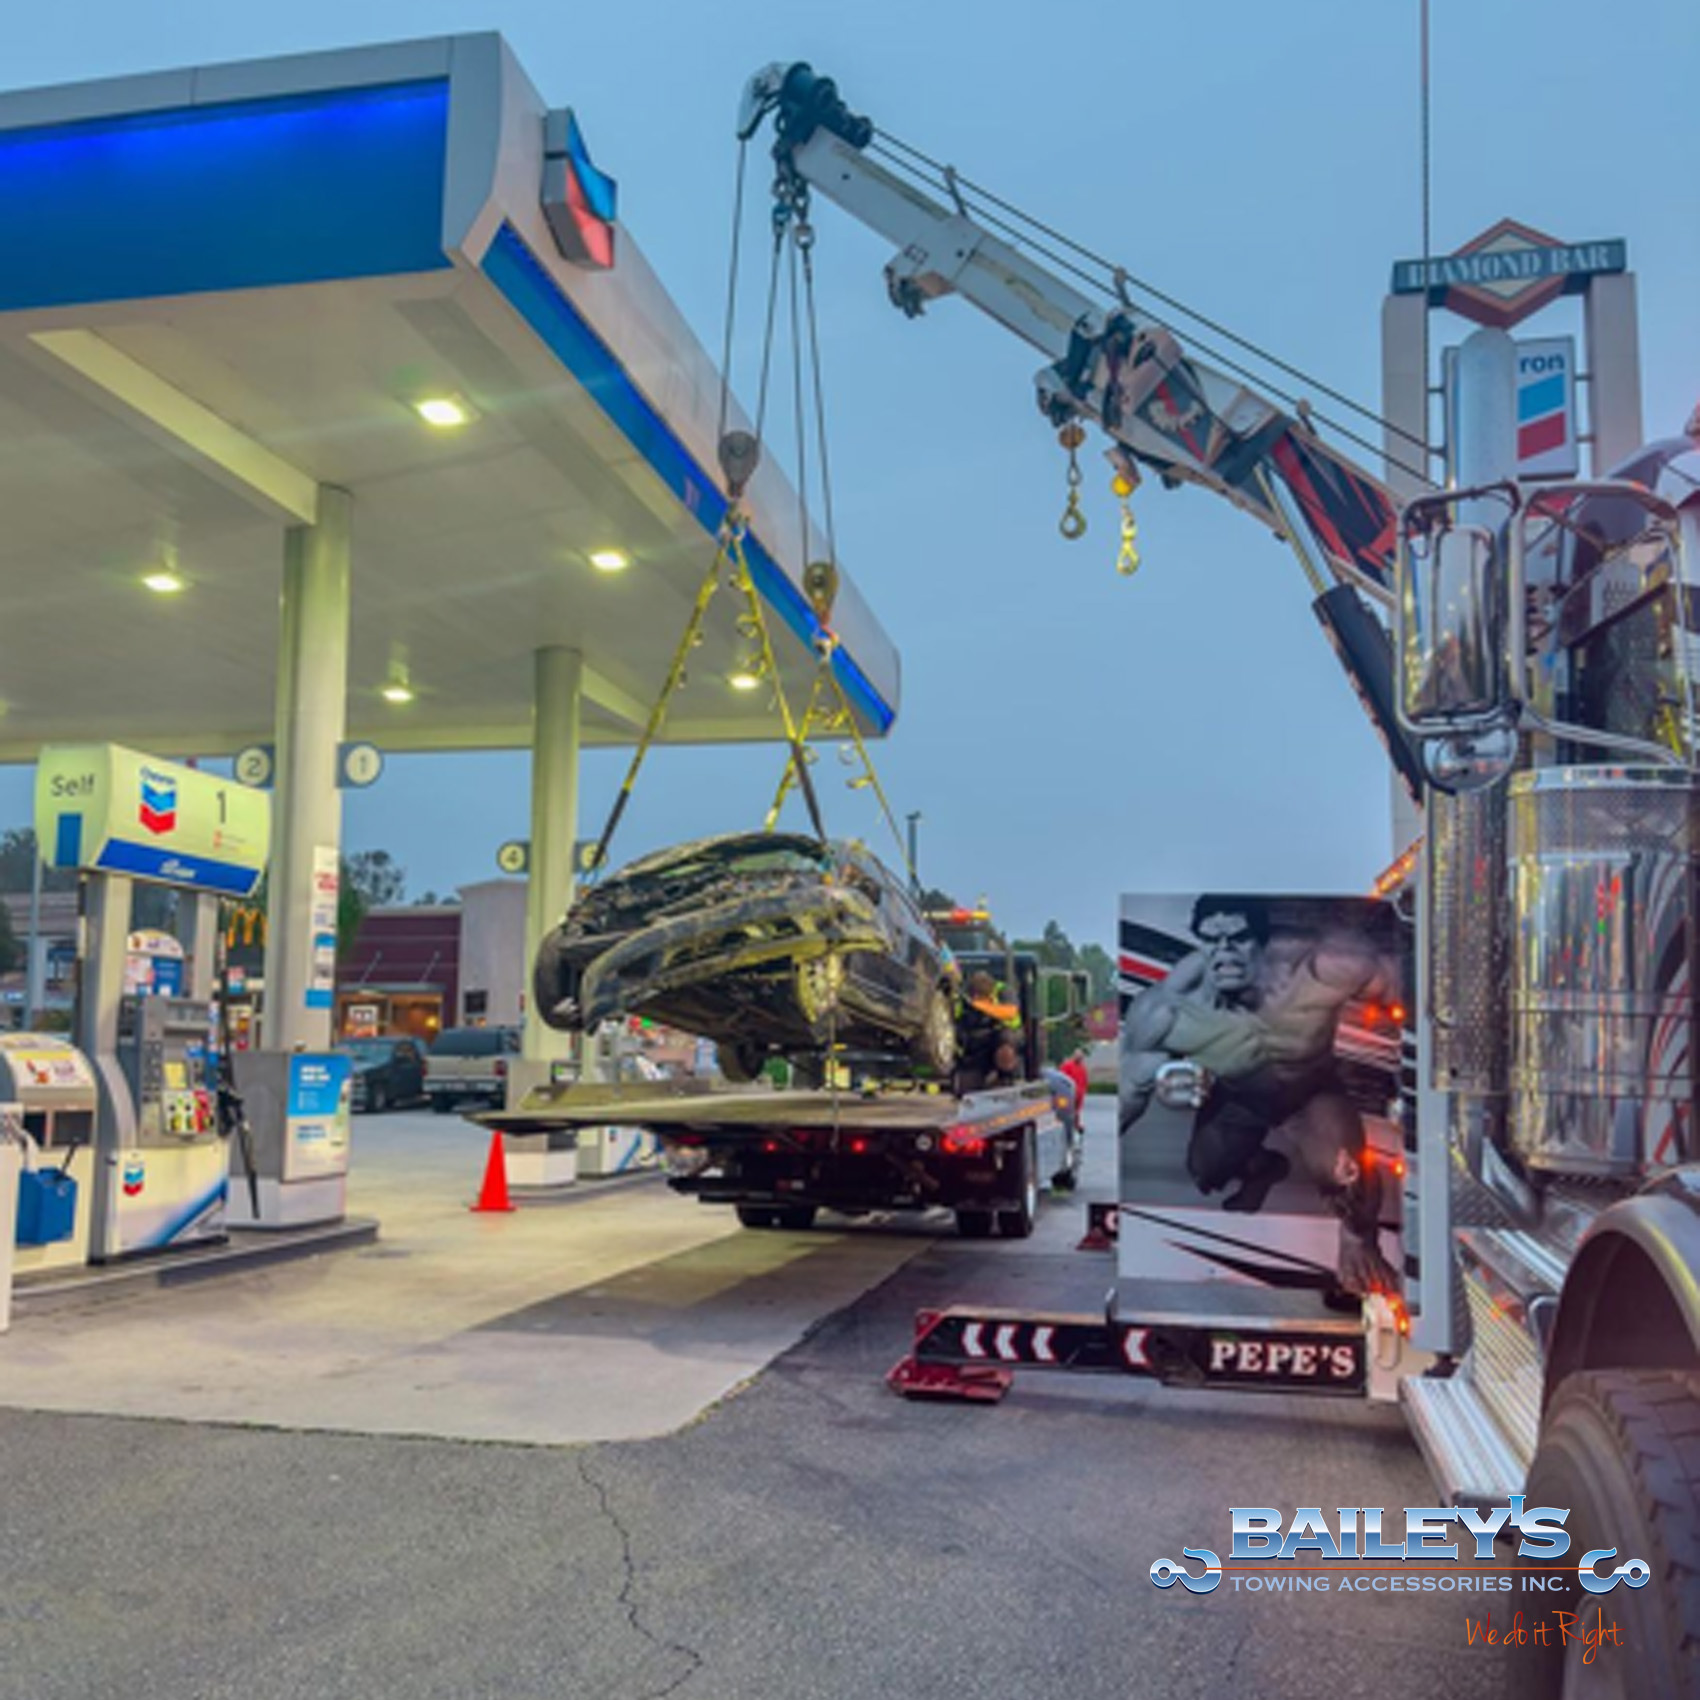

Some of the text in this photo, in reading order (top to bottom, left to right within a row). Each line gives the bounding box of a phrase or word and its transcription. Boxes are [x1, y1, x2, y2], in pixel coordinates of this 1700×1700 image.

[1407, 245, 1609, 286] DIAMOND BAR
[247, 756, 262, 778] 2
[50, 774, 95, 797] Self
[217, 790, 227, 825] 1
[1210, 1340, 1356, 1377] PEPE'S
